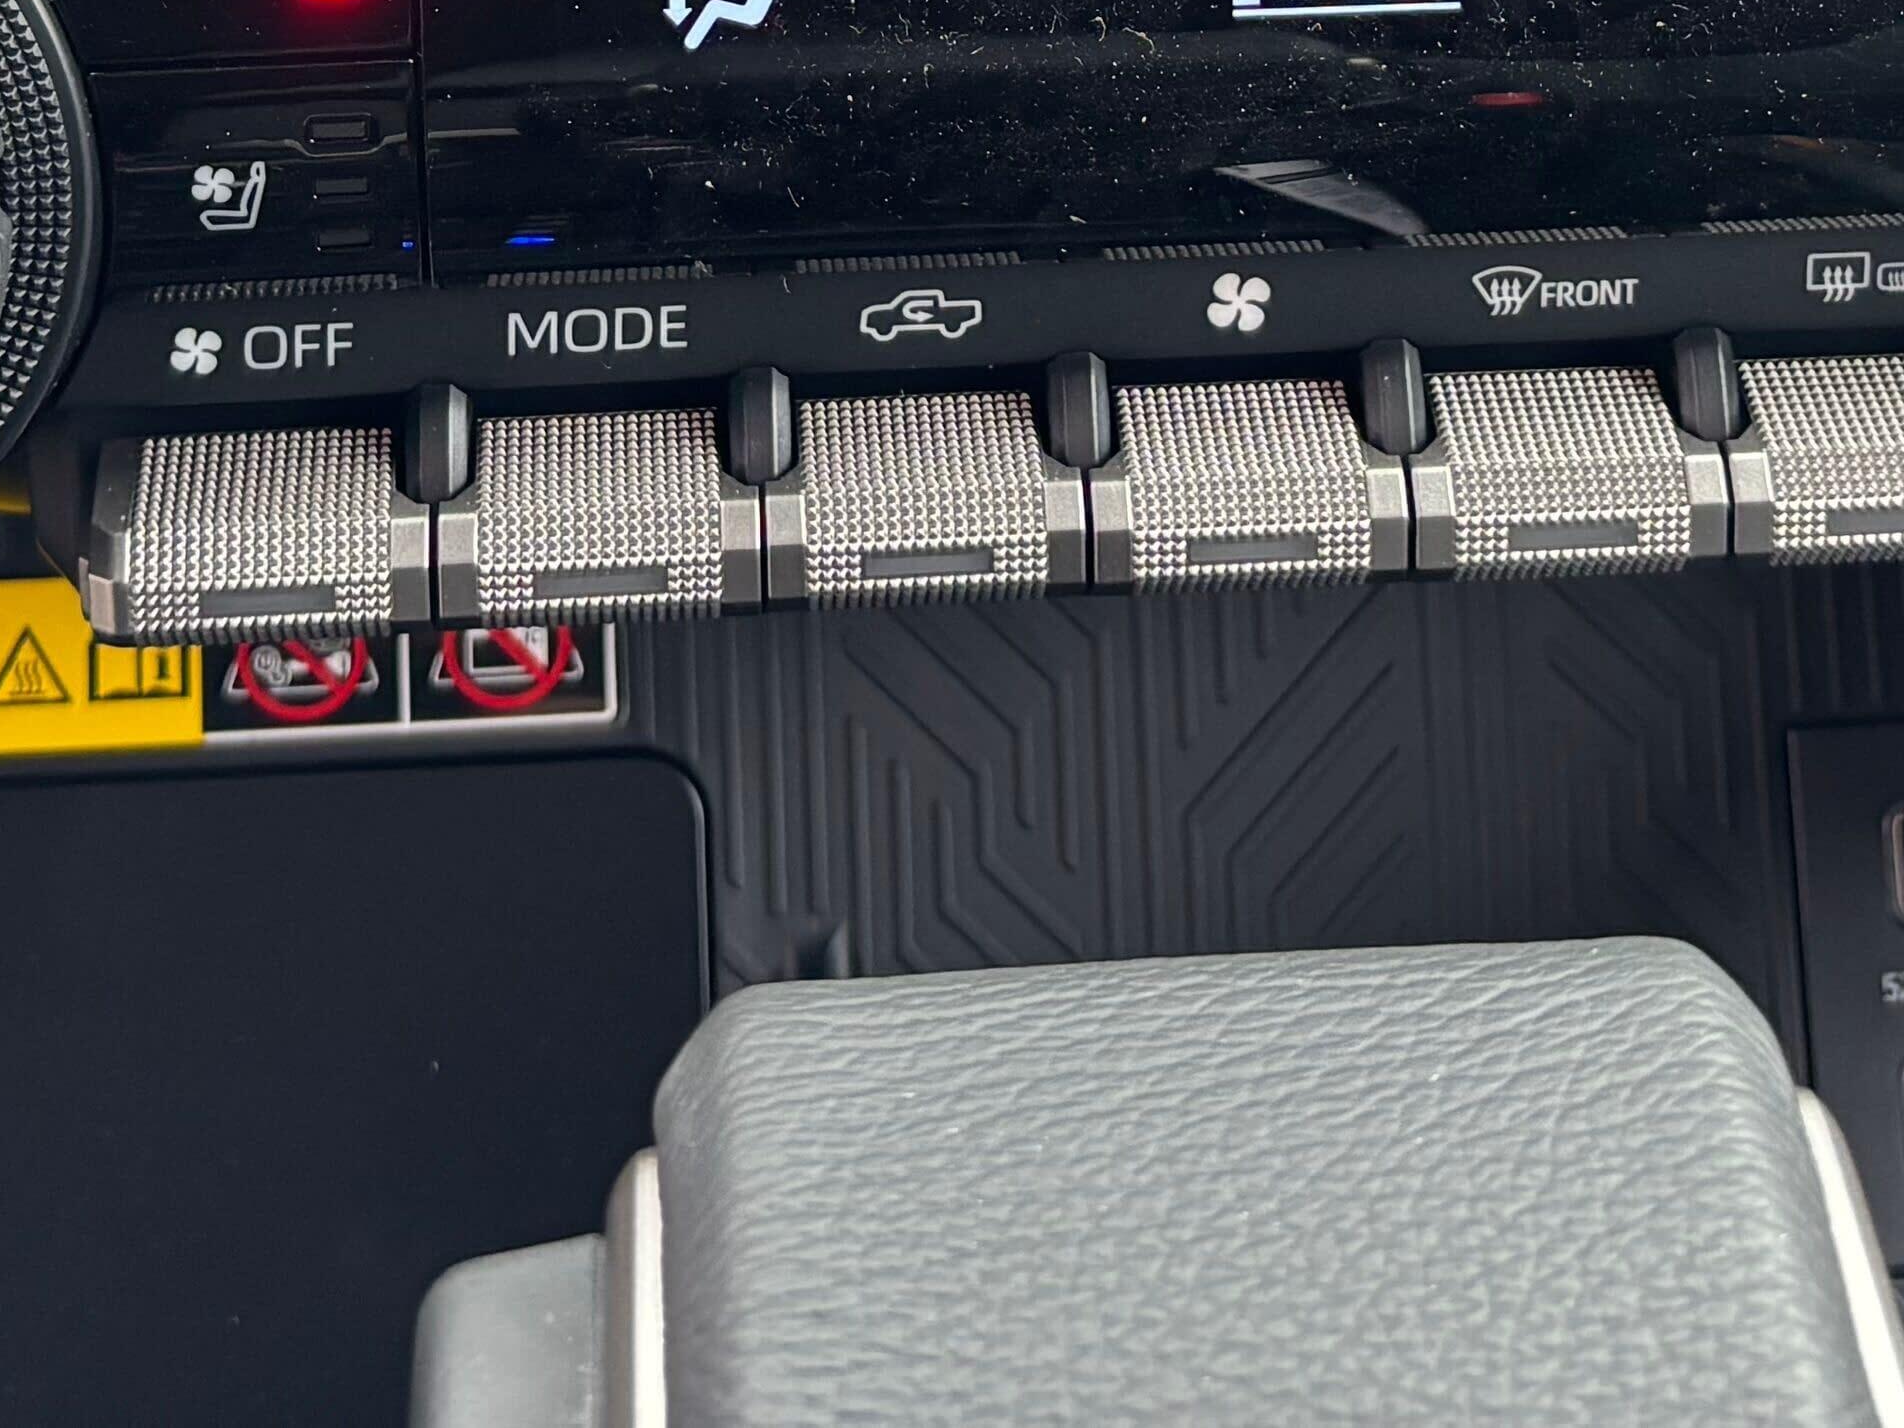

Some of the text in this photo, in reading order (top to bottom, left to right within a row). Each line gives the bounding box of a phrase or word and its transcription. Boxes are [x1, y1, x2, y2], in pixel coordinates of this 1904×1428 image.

[1540, 276, 1639, 309] FRONT
[243, 321, 354, 370] OFF
[507, 303, 689, 357] MODE
